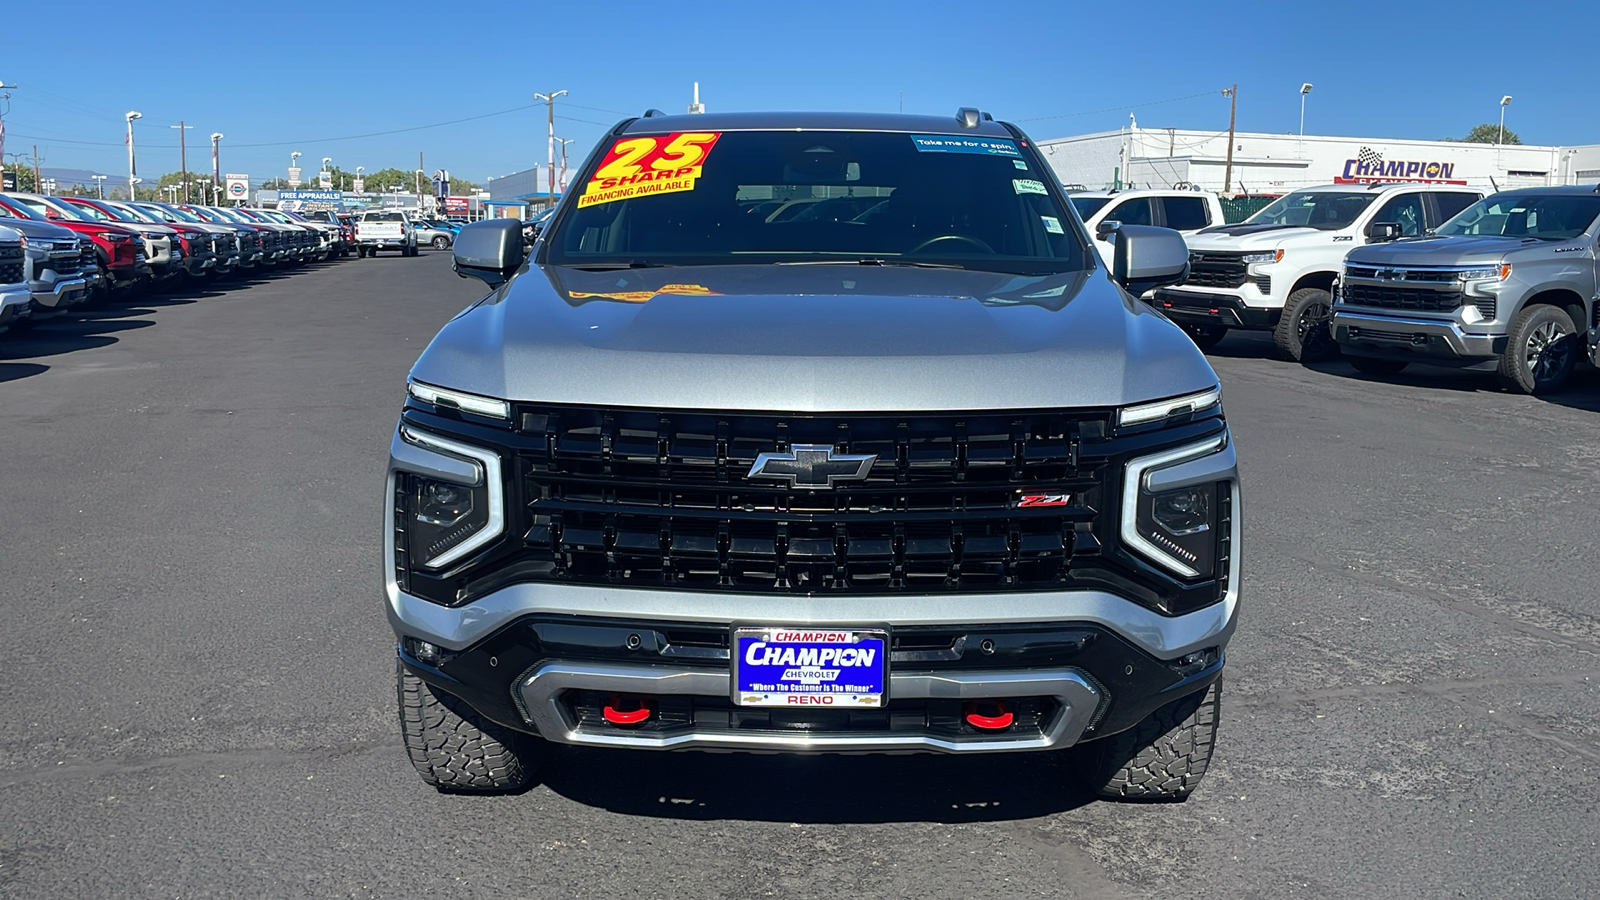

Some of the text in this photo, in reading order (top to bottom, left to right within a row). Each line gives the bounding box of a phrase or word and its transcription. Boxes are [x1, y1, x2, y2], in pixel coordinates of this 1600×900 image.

[596, 133, 717, 178] 25
[1342, 159, 1455, 179] CHAMPION
[600, 167, 695, 189] SHARP
[298, 192, 341, 200] APPRAISALS!
[581, 180, 691, 205] FINANCING AVAILABLE
[1017, 494, 1071, 507] Z71
[775, 632, 847, 642] CHAMPION
[745, 642, 876, 667] CHAMPION
[785, 670, 836, 679] CHEVROLET
[776, 684, 789, 692] The
[790, 684, 822, 692] Customer
[823, 684, 830, 692] Is
[831, 684, 844, 692] The
[787, 695, 834, 705] RENO
